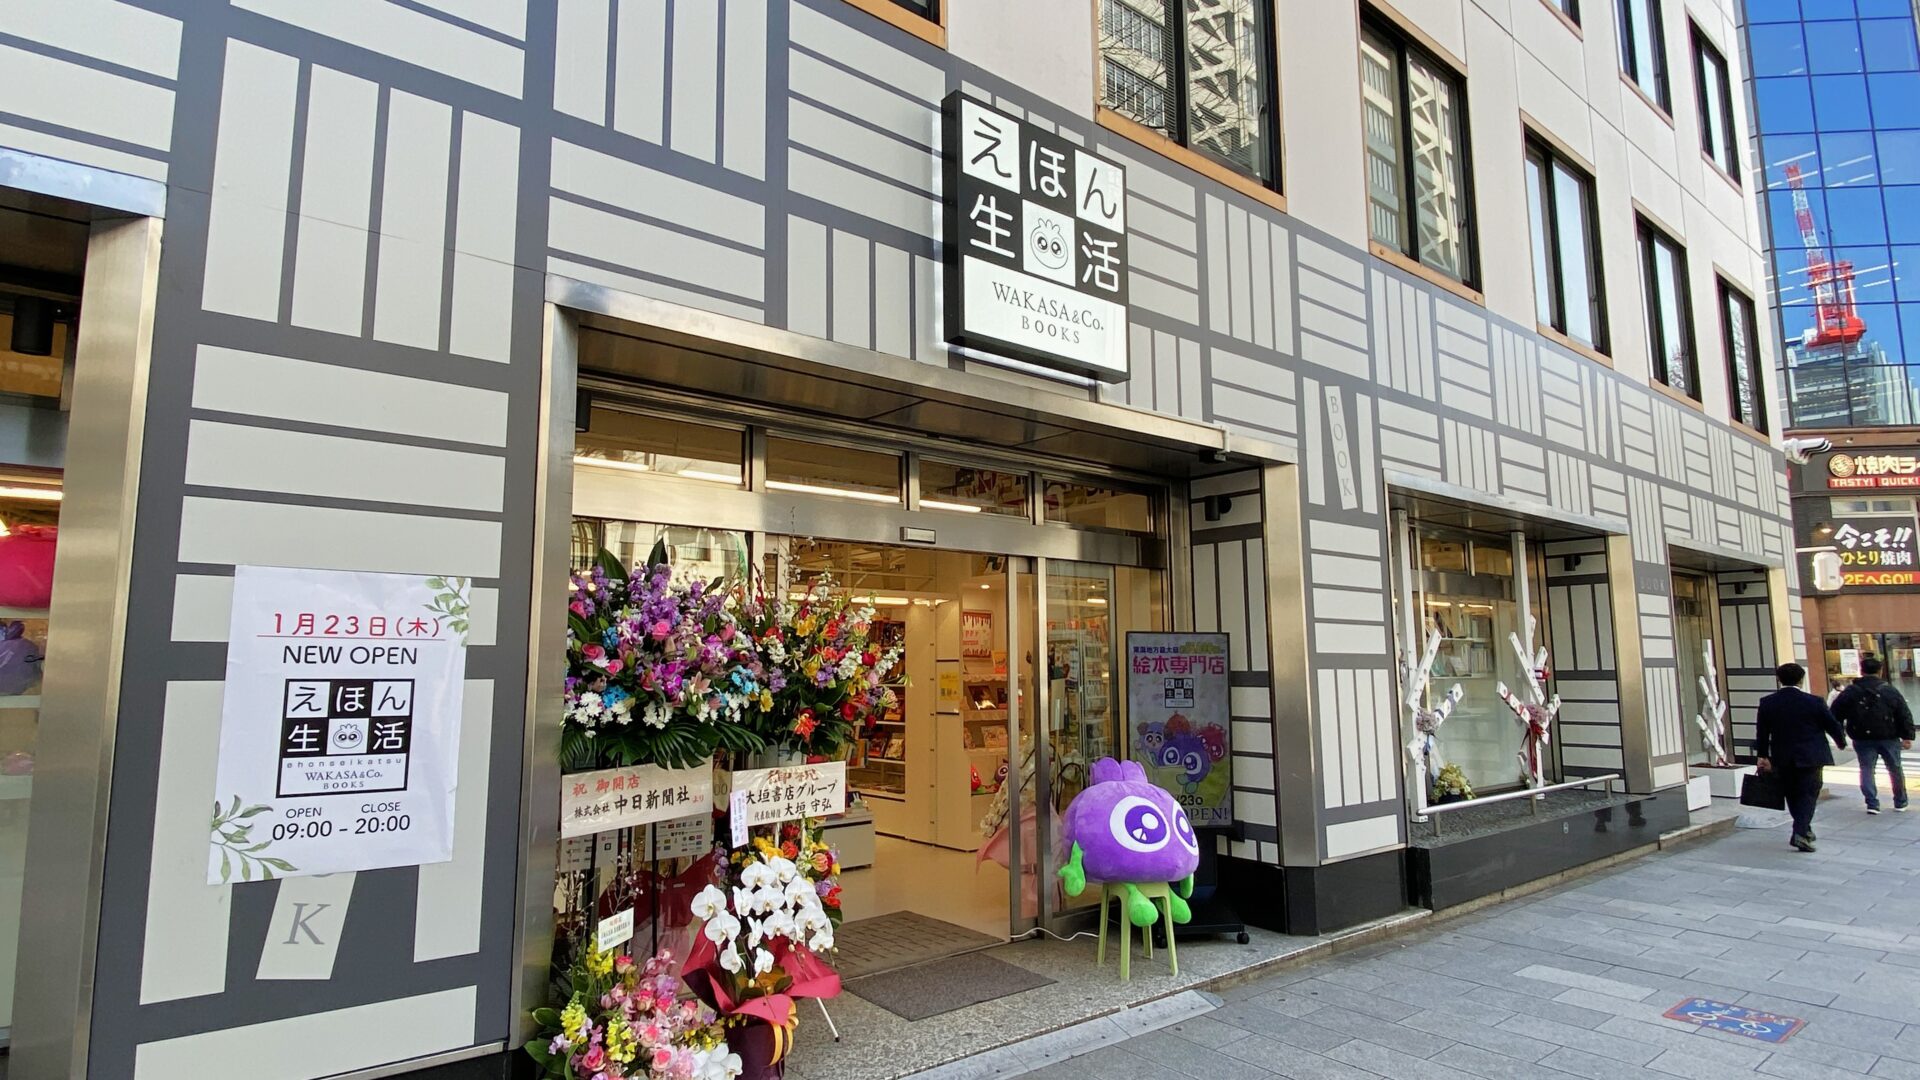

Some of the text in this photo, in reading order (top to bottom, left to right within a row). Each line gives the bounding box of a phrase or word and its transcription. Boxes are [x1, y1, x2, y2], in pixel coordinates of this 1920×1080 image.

[970, 116, 1117, 221] えほん
[991, 281, 1105, 331] WAKASA&Co.
[1021, 315, 1081, 344] BOOKS
[1329, 396, 1353, 496] BOOK
[1854, 455, 1920, 475] 焼肉ラ
[1831, 477, 1919, 487] TASTY! QUICK!
[1833, 523, 1913, 549] 今こそ!!
[1840, 550, 1912, 565] ひとり焼肉
[274, 612, 441, 638] 1月23日(木)
[282, 645, 418, 666] NEW OPEN
[1133, 655, 1225, 675] 絵本専門店
[292, 685, 407, 714] えほん
[323, 781, 365, 790] BOOKS
[571, 774, 641, 797] 祝 御開店
[746, 779, 838, 805] 大垣書店グループ
[286, 801, 401, 819] OPEN CLOSE
[574, 802, 611, 819] 株式会社
[614, 784, 690, 815] 中日新聞社
[784, 802, 806, 817] 大垣
[811, 797, 832, 813] 守弘
[272, 821, 333, 841] 09:00
[354, 815, 411, 835] 20:00
